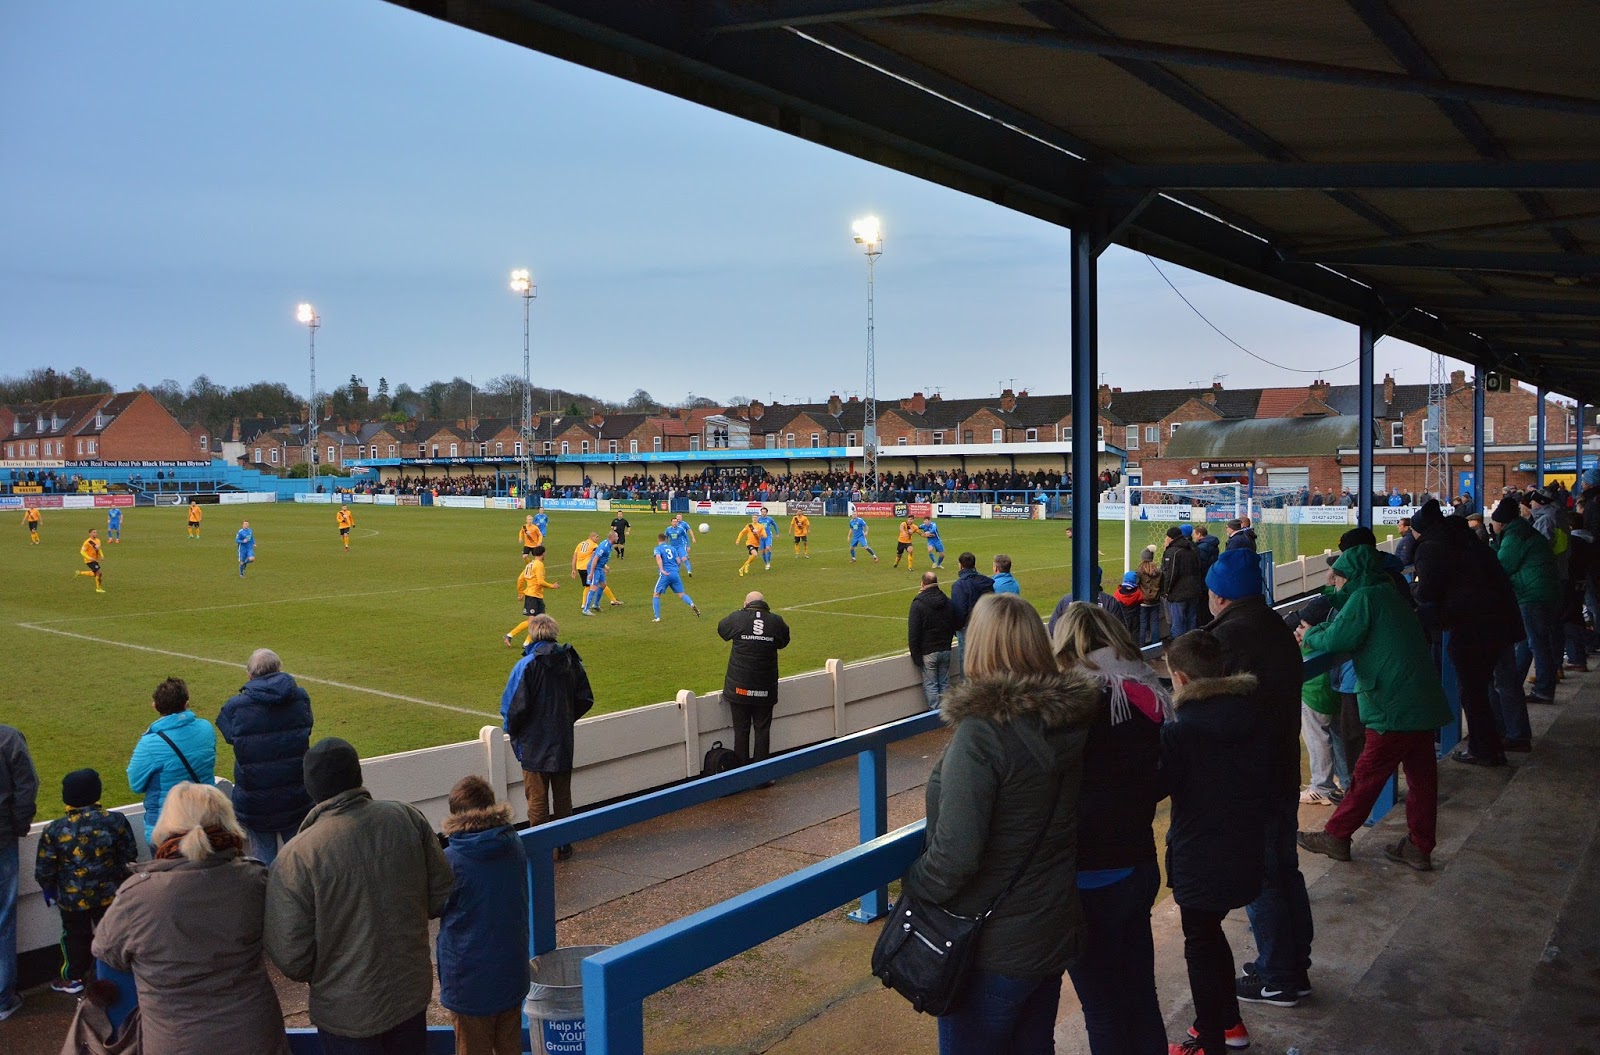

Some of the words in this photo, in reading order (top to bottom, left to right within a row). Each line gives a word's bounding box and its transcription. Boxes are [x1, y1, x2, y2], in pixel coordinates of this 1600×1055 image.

[1382, 507, 1409, 515] Foster
[665, 548, 673, 560] 3
[549, 1021, 571, 1032] Help
[546, 1041, 583, 1052] Ground
